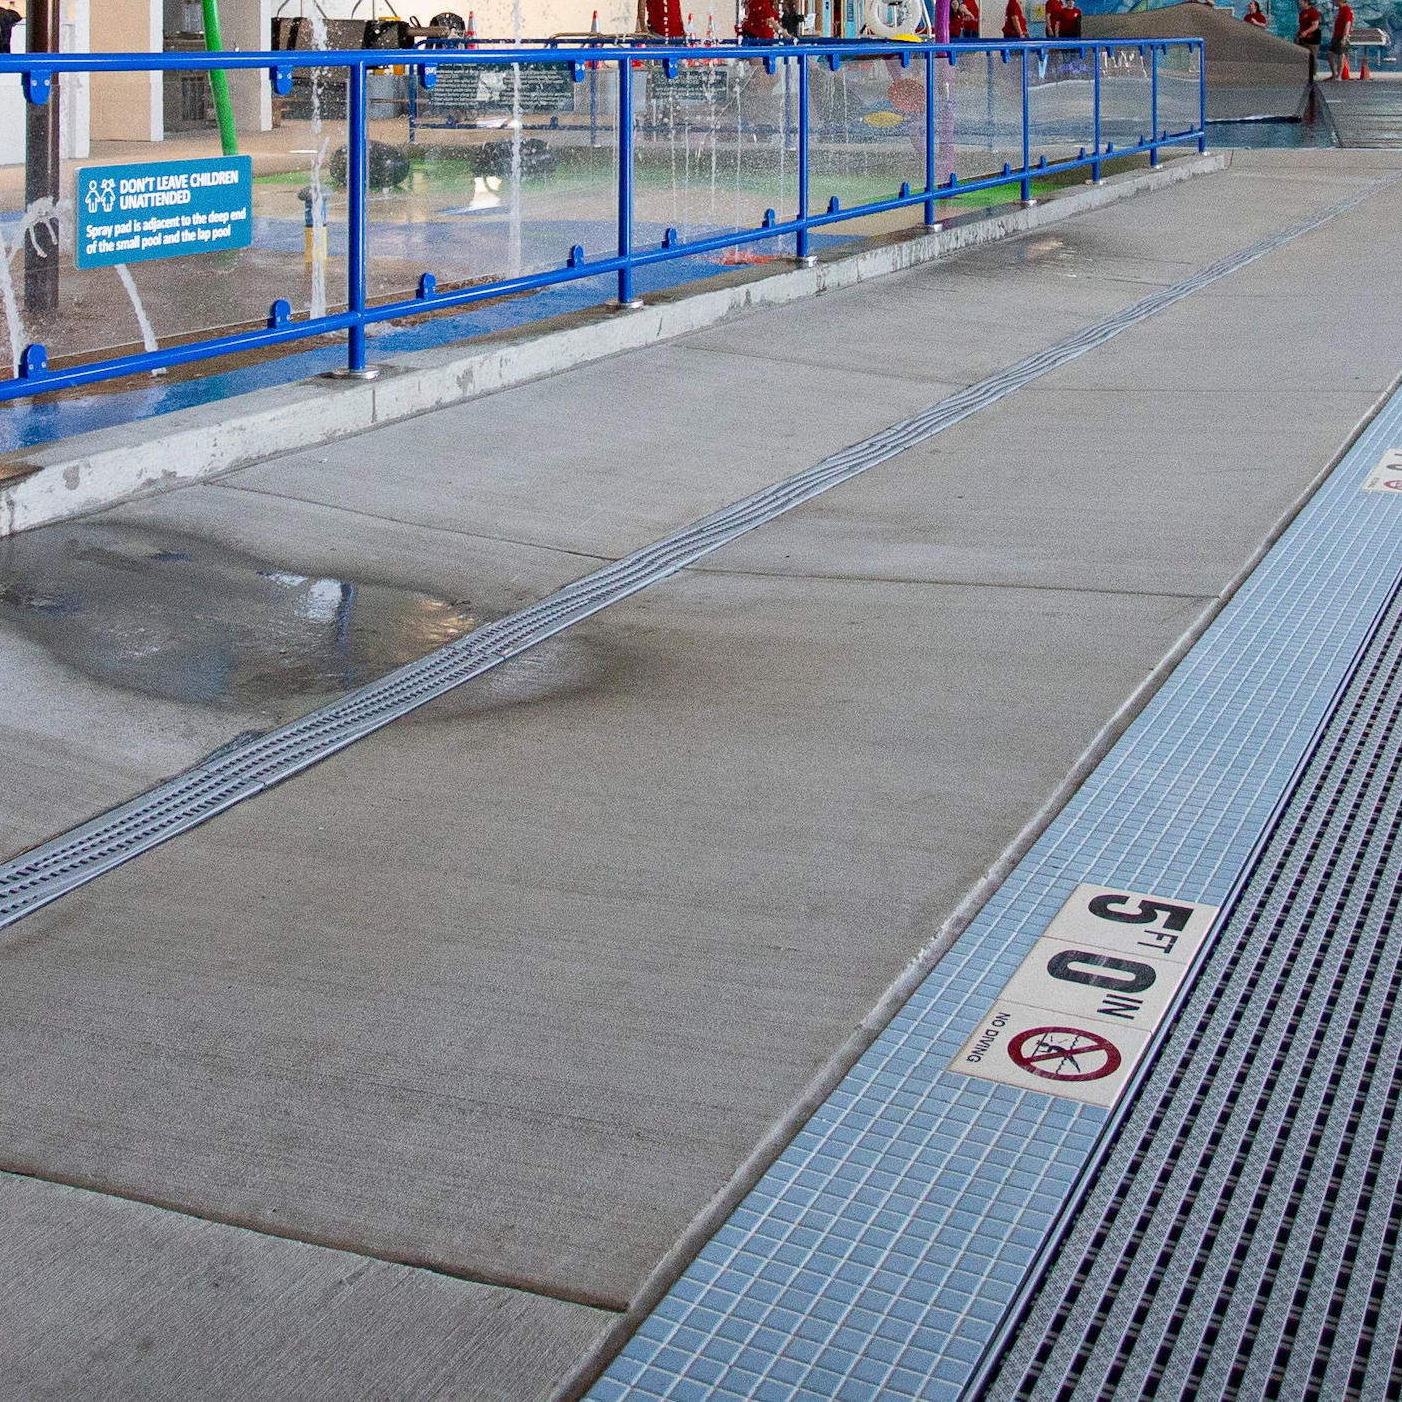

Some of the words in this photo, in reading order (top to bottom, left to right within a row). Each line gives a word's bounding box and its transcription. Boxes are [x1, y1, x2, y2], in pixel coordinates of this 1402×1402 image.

[156, 174, 187, 190] LEAVE
[189, 170, 238, 187] CHILDREN
[119, 189, 190, 209] UNATTENDED
[85, 224, 113, 239] Spray
[114, 219, 132, 237] pad
[133, 219, 141, 232] is
[142, 215, 180, 232] adjacent
[180, 215, 191, 226] to
[191, 212, 207, 225] the
[207, 210, 229, 224] deep
[229, 207, 246, 220] end
[85, 240, 97, 254] of
[97, 239, 114, 252] the
[115, 234, 140, 250] small
[141, 232, 161, 249] pool
[162, 230, 180, 244] and
[180, 229, 196, 242] the
[197, 227, 211, 241] lap
[211, 223, 231, 240] pool
[1088, 894, 1194, 932] 5
[1137, 929, 1179, 954] FT
[991, 1012, 1011, 1028] NO
[1096, 993, 1144, 1021] IN
[966, 1028, 1000, 1063] DIVING
